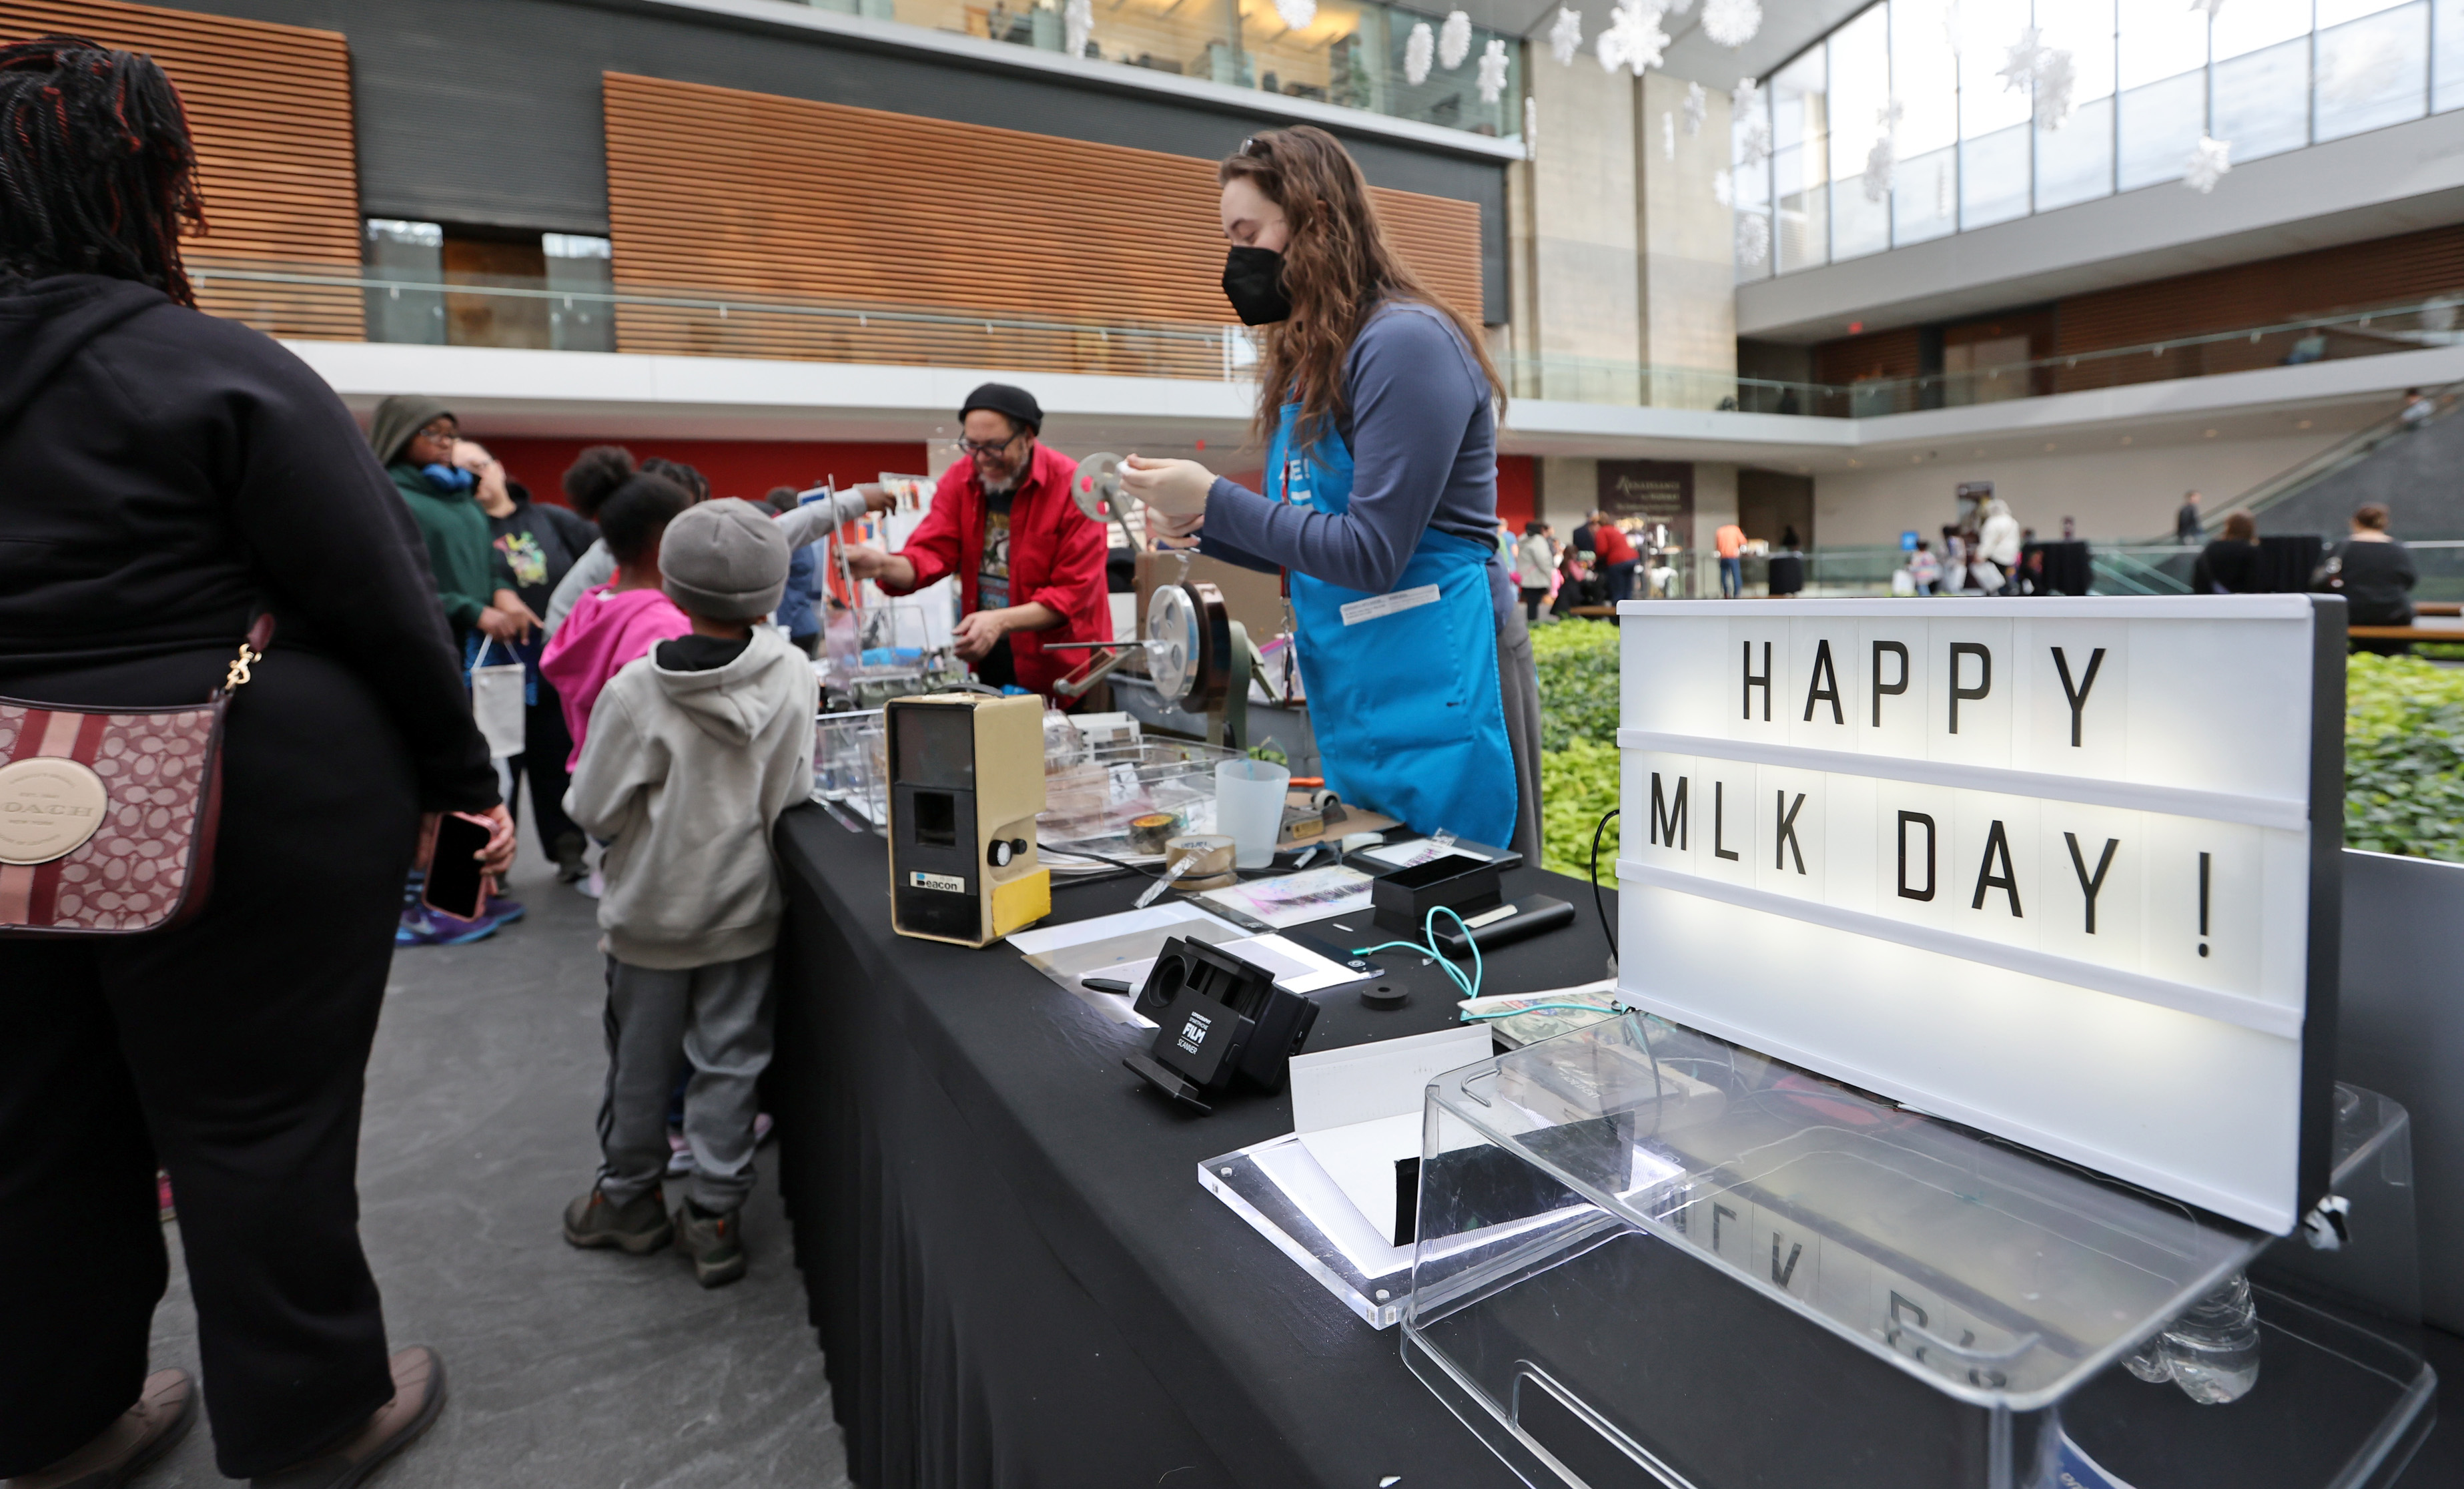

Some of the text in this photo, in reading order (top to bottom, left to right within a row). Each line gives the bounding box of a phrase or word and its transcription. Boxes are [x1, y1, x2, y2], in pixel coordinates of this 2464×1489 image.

[1743, 639, 2106, 747] HAPPY
[1651, 772, 2209, 957] MLK DAY!
[916, 872, 957, 891] Beacon
[1182, 1022, 1206, 1044] FILM
[1177, 1038, 1198, 1055] SCANNER
